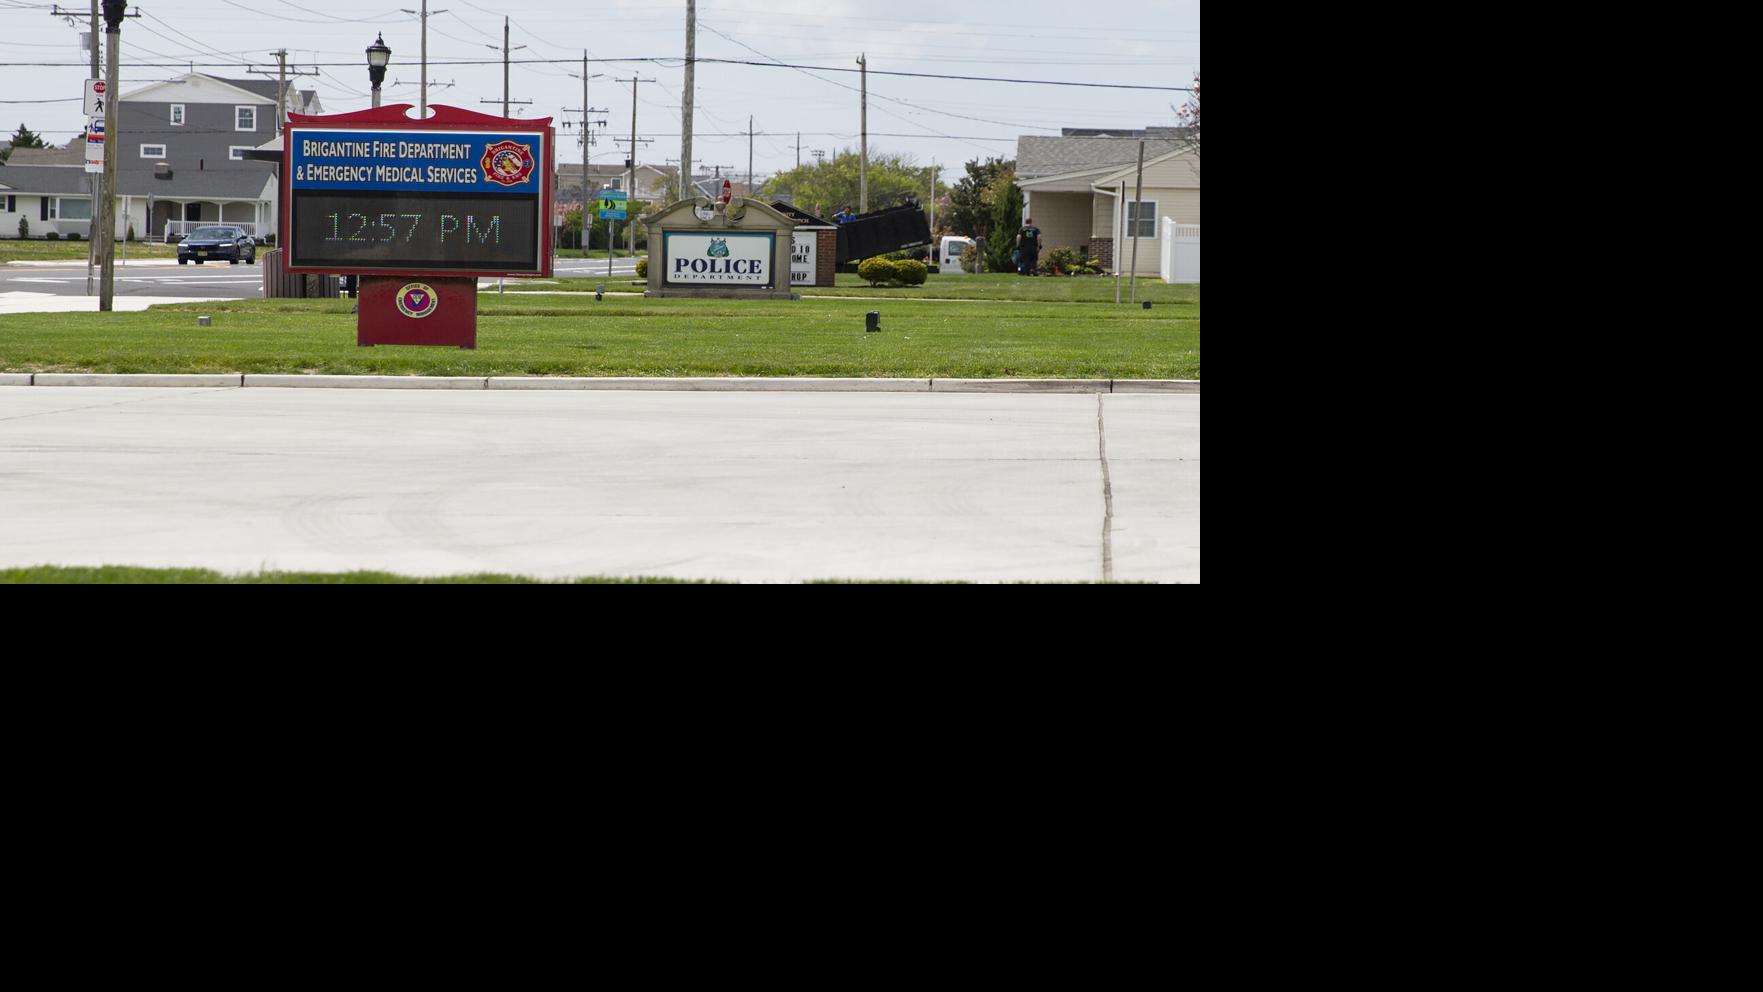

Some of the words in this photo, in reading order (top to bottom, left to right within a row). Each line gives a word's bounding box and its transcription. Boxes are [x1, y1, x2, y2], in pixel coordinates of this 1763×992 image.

[303, 140, 370, 157] BRIGANTINE
[373, 141, 396, 158] FIRE
[399, 142, 471, 159] DEPARTMENT
[296, 165, 304, 181] &
[307, 164, 373, 182] EMERGENCY
[376, 165, 425, 183] MEDICAL
[427, 165, 477, 184] SERVICES
[325, 213, 422, 242] 12:57
[441, 214, 500, 243] PM
[674, 258, 762, 274] POLICE
